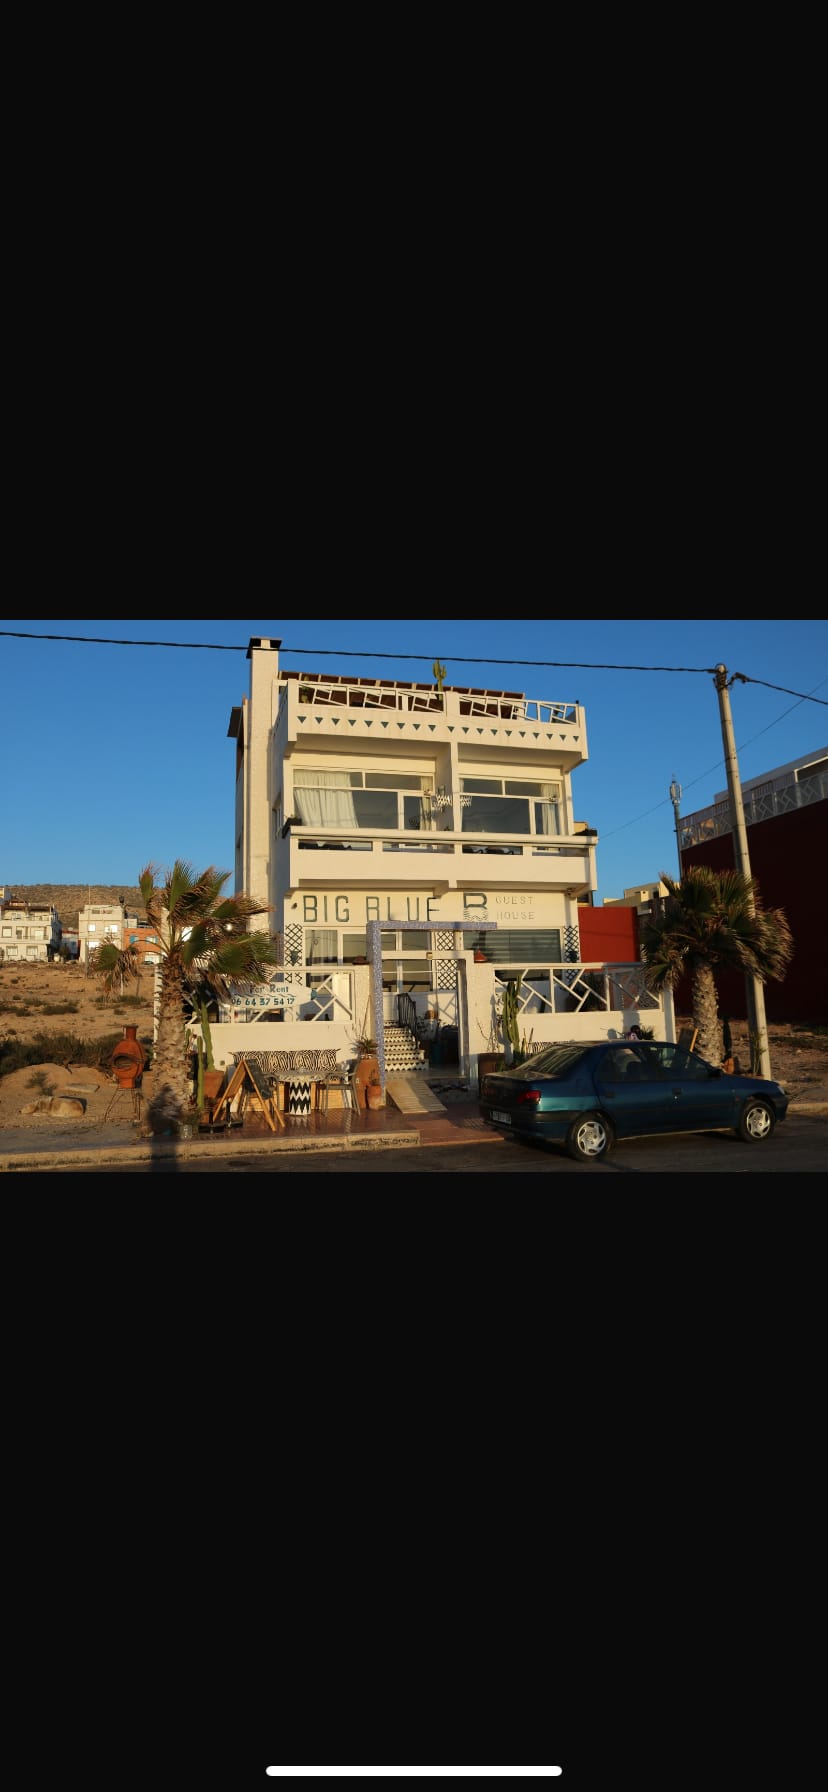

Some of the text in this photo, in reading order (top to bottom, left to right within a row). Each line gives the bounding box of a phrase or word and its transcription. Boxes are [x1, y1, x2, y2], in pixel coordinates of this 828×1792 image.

[495, 896, 534, 905] GUEST
[303, 895, 440, 922] BIG BLUE
[496, 911, 535, 920] HOUSE
[269, 984, 289, 993] Rent
[245, 998, 256, 1006] 64
[259, 998, 271, 1006] 37
[273, 998, 284, 1006] 54
[287, 997, 295, 1005] 17
